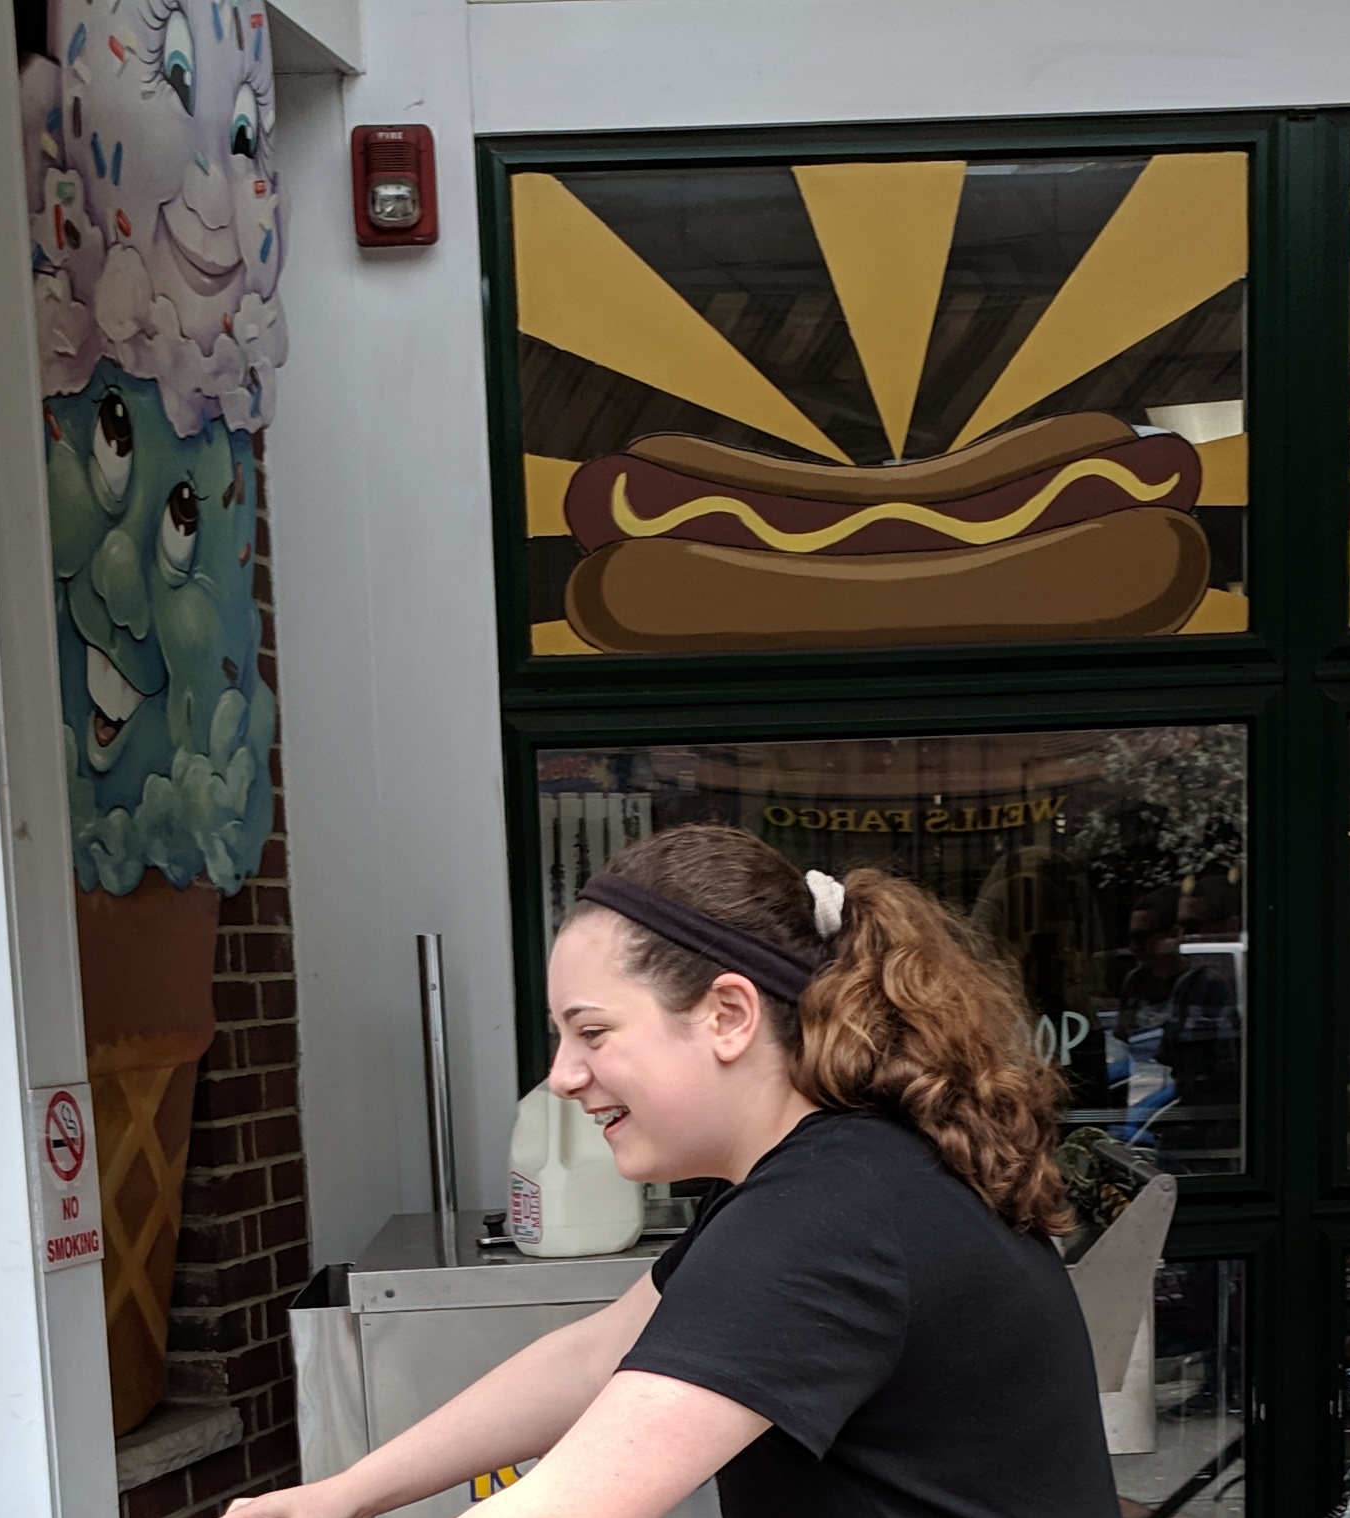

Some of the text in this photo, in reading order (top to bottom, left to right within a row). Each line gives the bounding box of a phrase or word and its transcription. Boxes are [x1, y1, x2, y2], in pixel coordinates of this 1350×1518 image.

[377, 131, 404, 140] FIRE
[62, 1196, 79, 1220] NO
[47, 1229, 99, 1263] SMOKING
